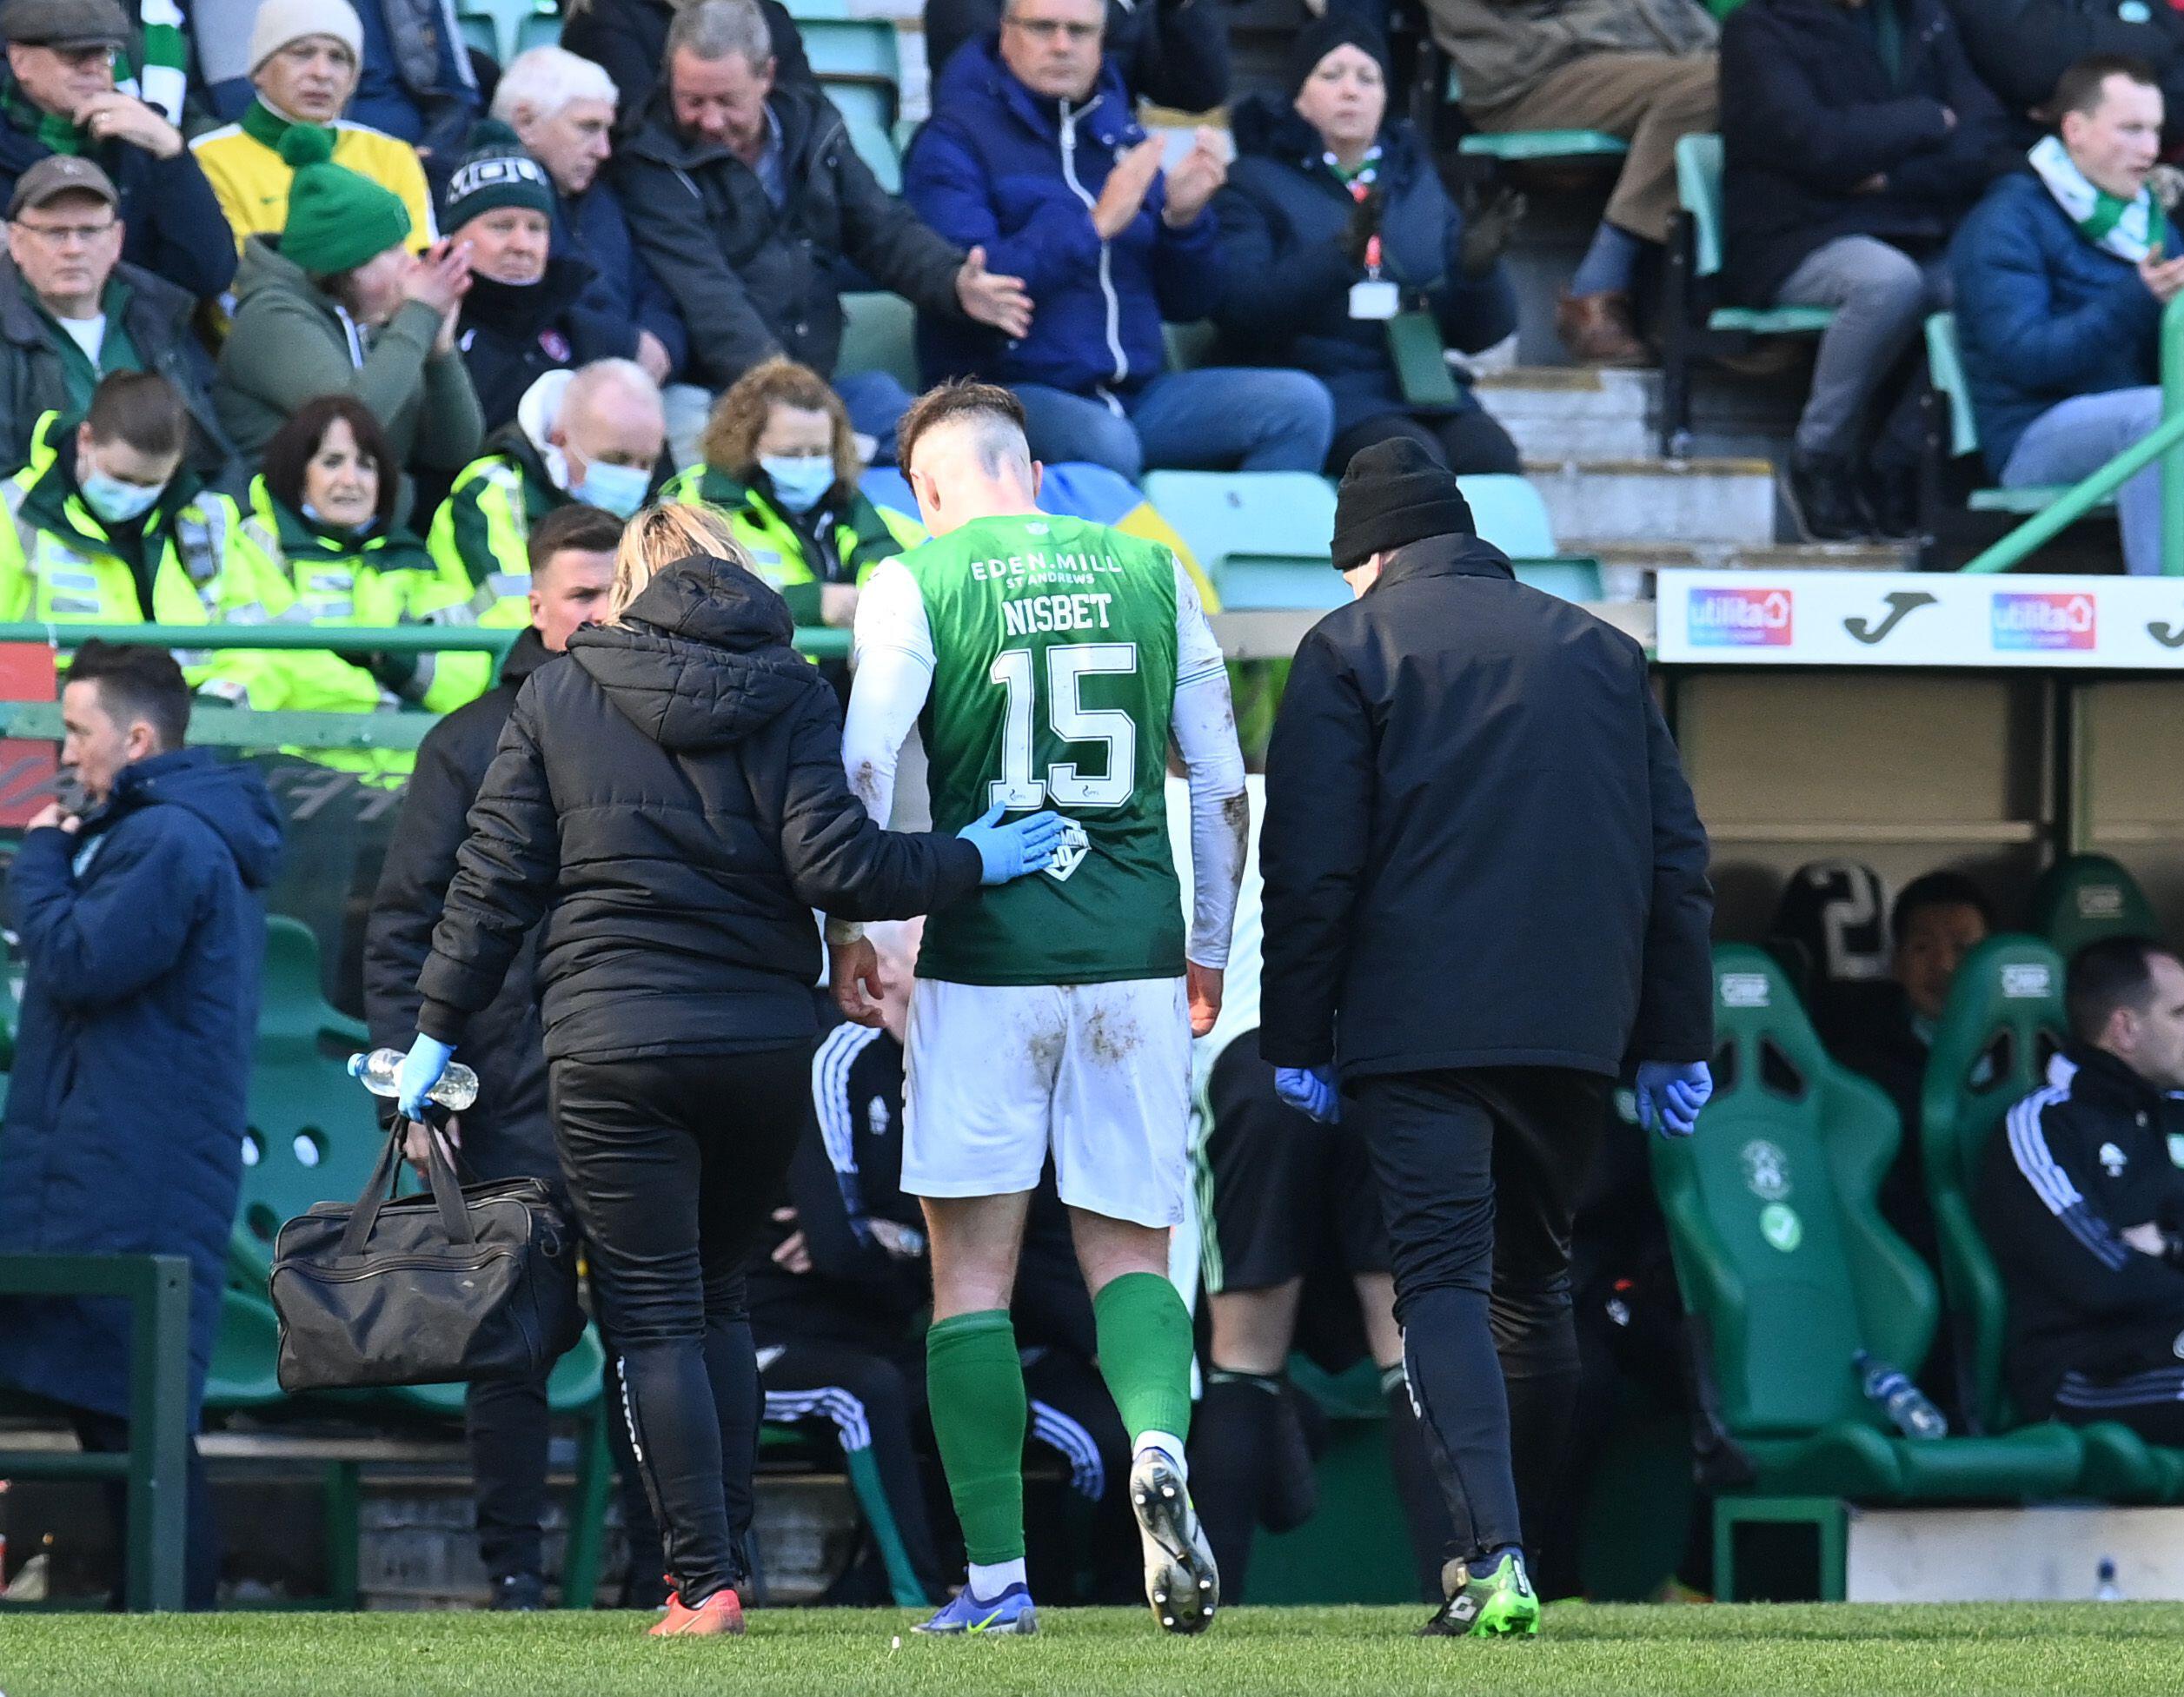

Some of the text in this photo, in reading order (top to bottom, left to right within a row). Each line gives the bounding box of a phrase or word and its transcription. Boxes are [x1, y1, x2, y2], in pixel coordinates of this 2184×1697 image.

[1006, 573, 1095, 588] ST ANDREWS
[1002, 593, 1112, 636] NISBET
[989, 642, 1137, 811] 15
